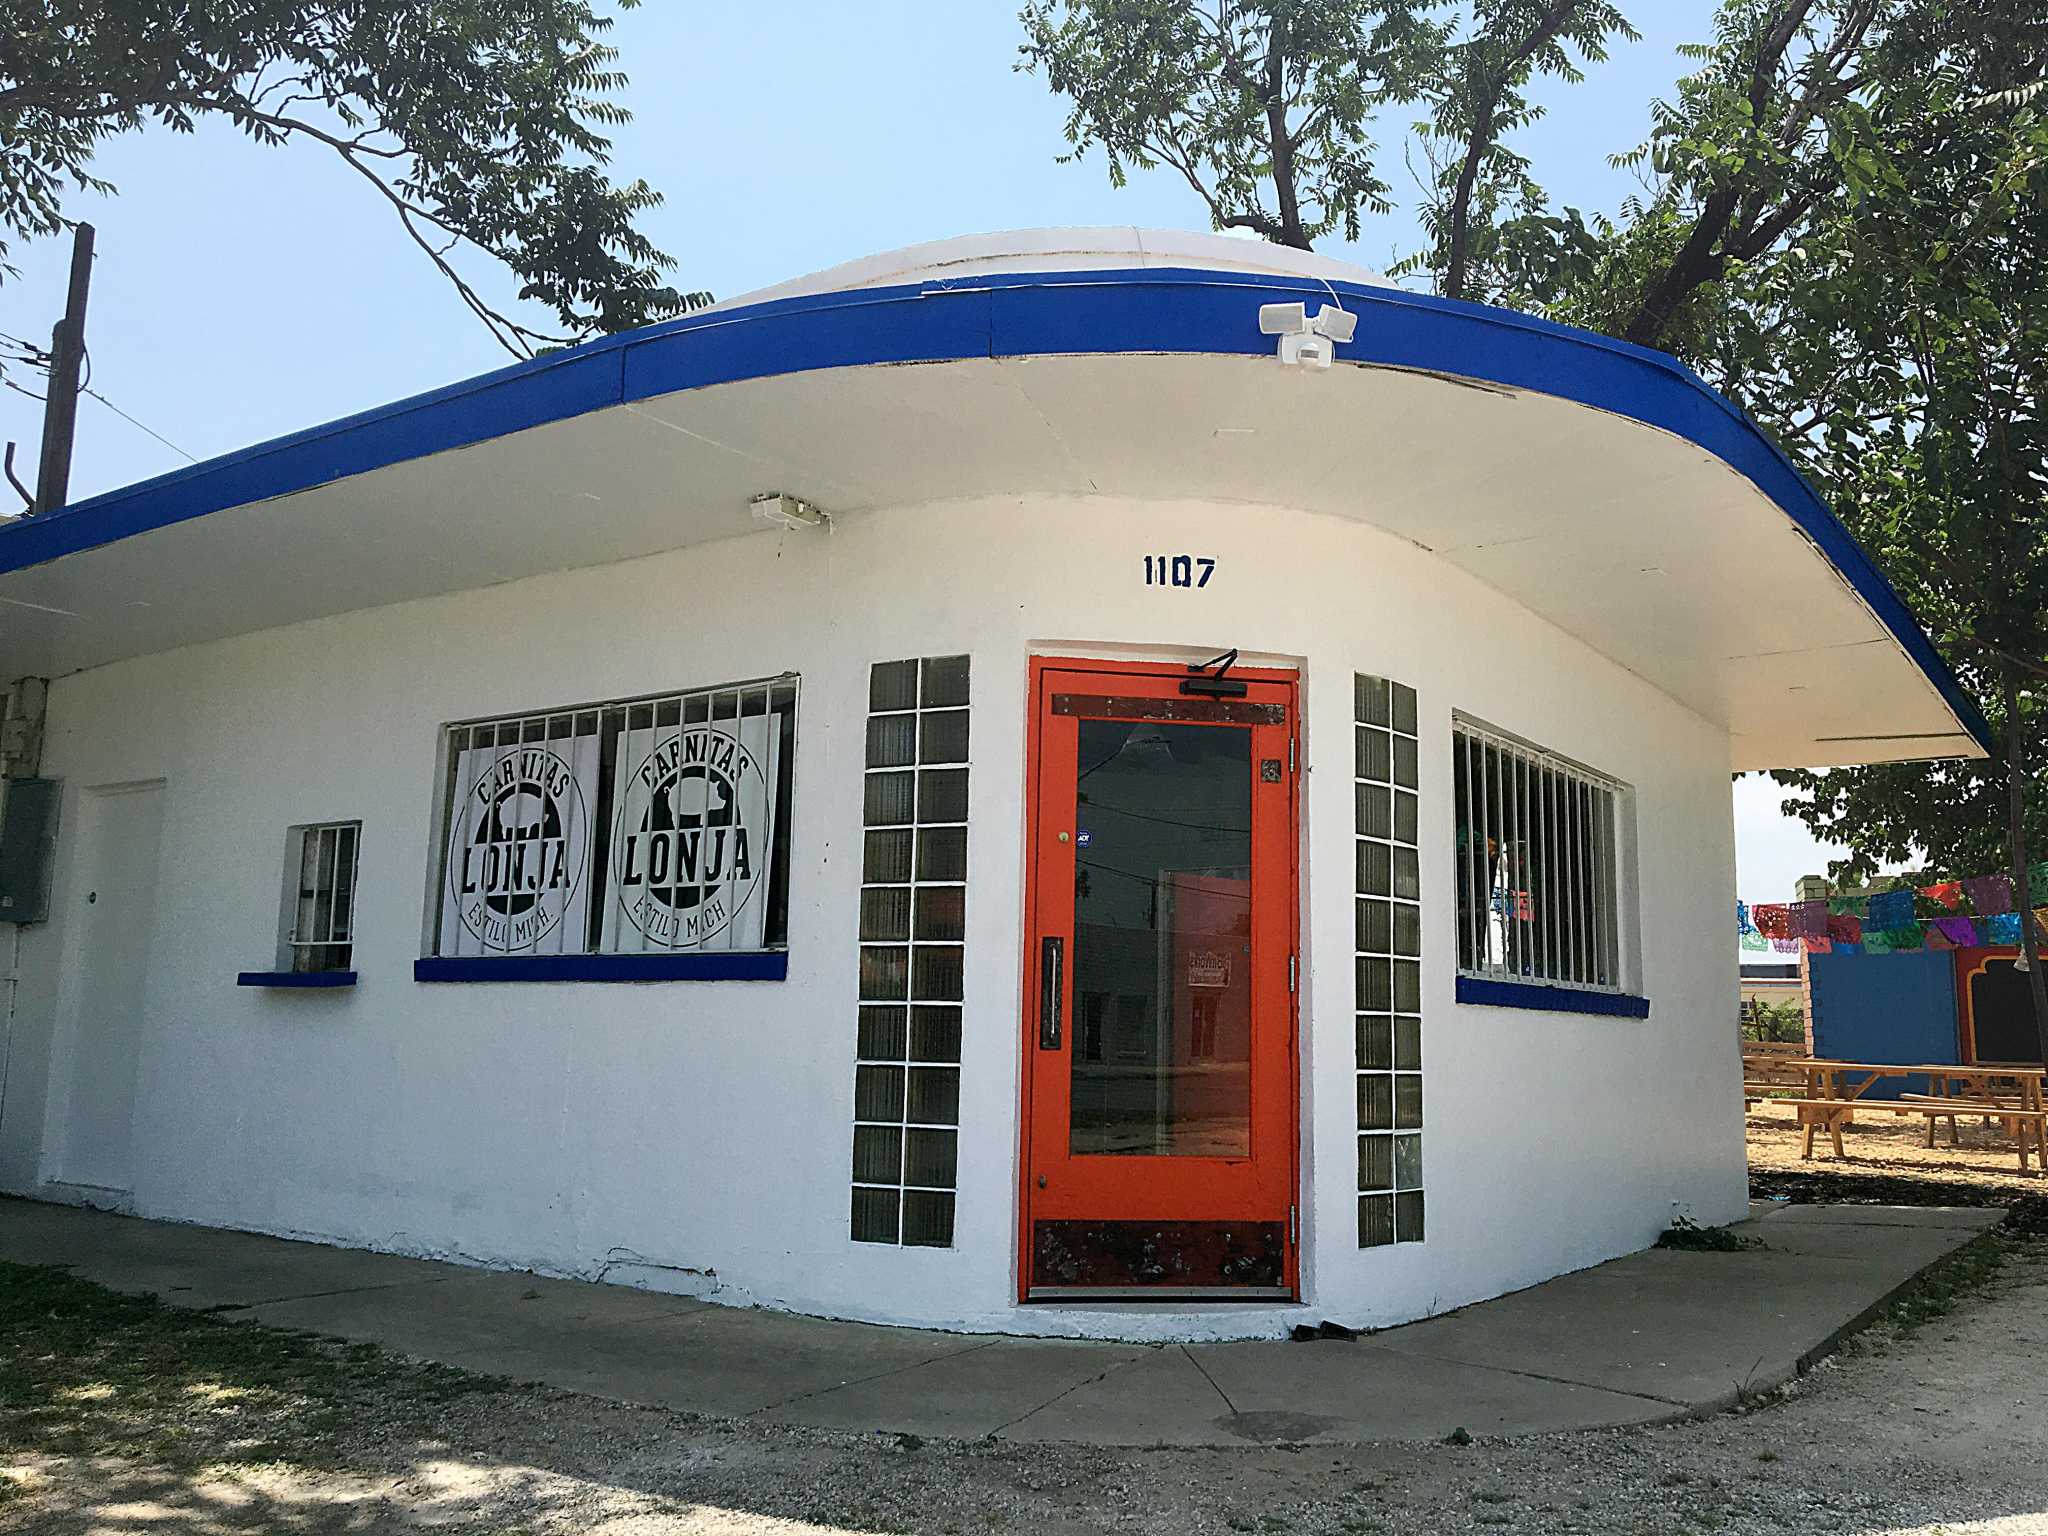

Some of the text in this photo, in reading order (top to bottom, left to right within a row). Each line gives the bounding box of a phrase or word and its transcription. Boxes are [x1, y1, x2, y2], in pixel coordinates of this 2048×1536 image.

[1143, 554, 1216, 588] 1107
[641, 733, 749, 788] CARNITAS
[461, 840, 571, 894] LONJA
[622, 827, 751, 886] LONJA
[633, 895, 726, 939] ESTILO MCH
